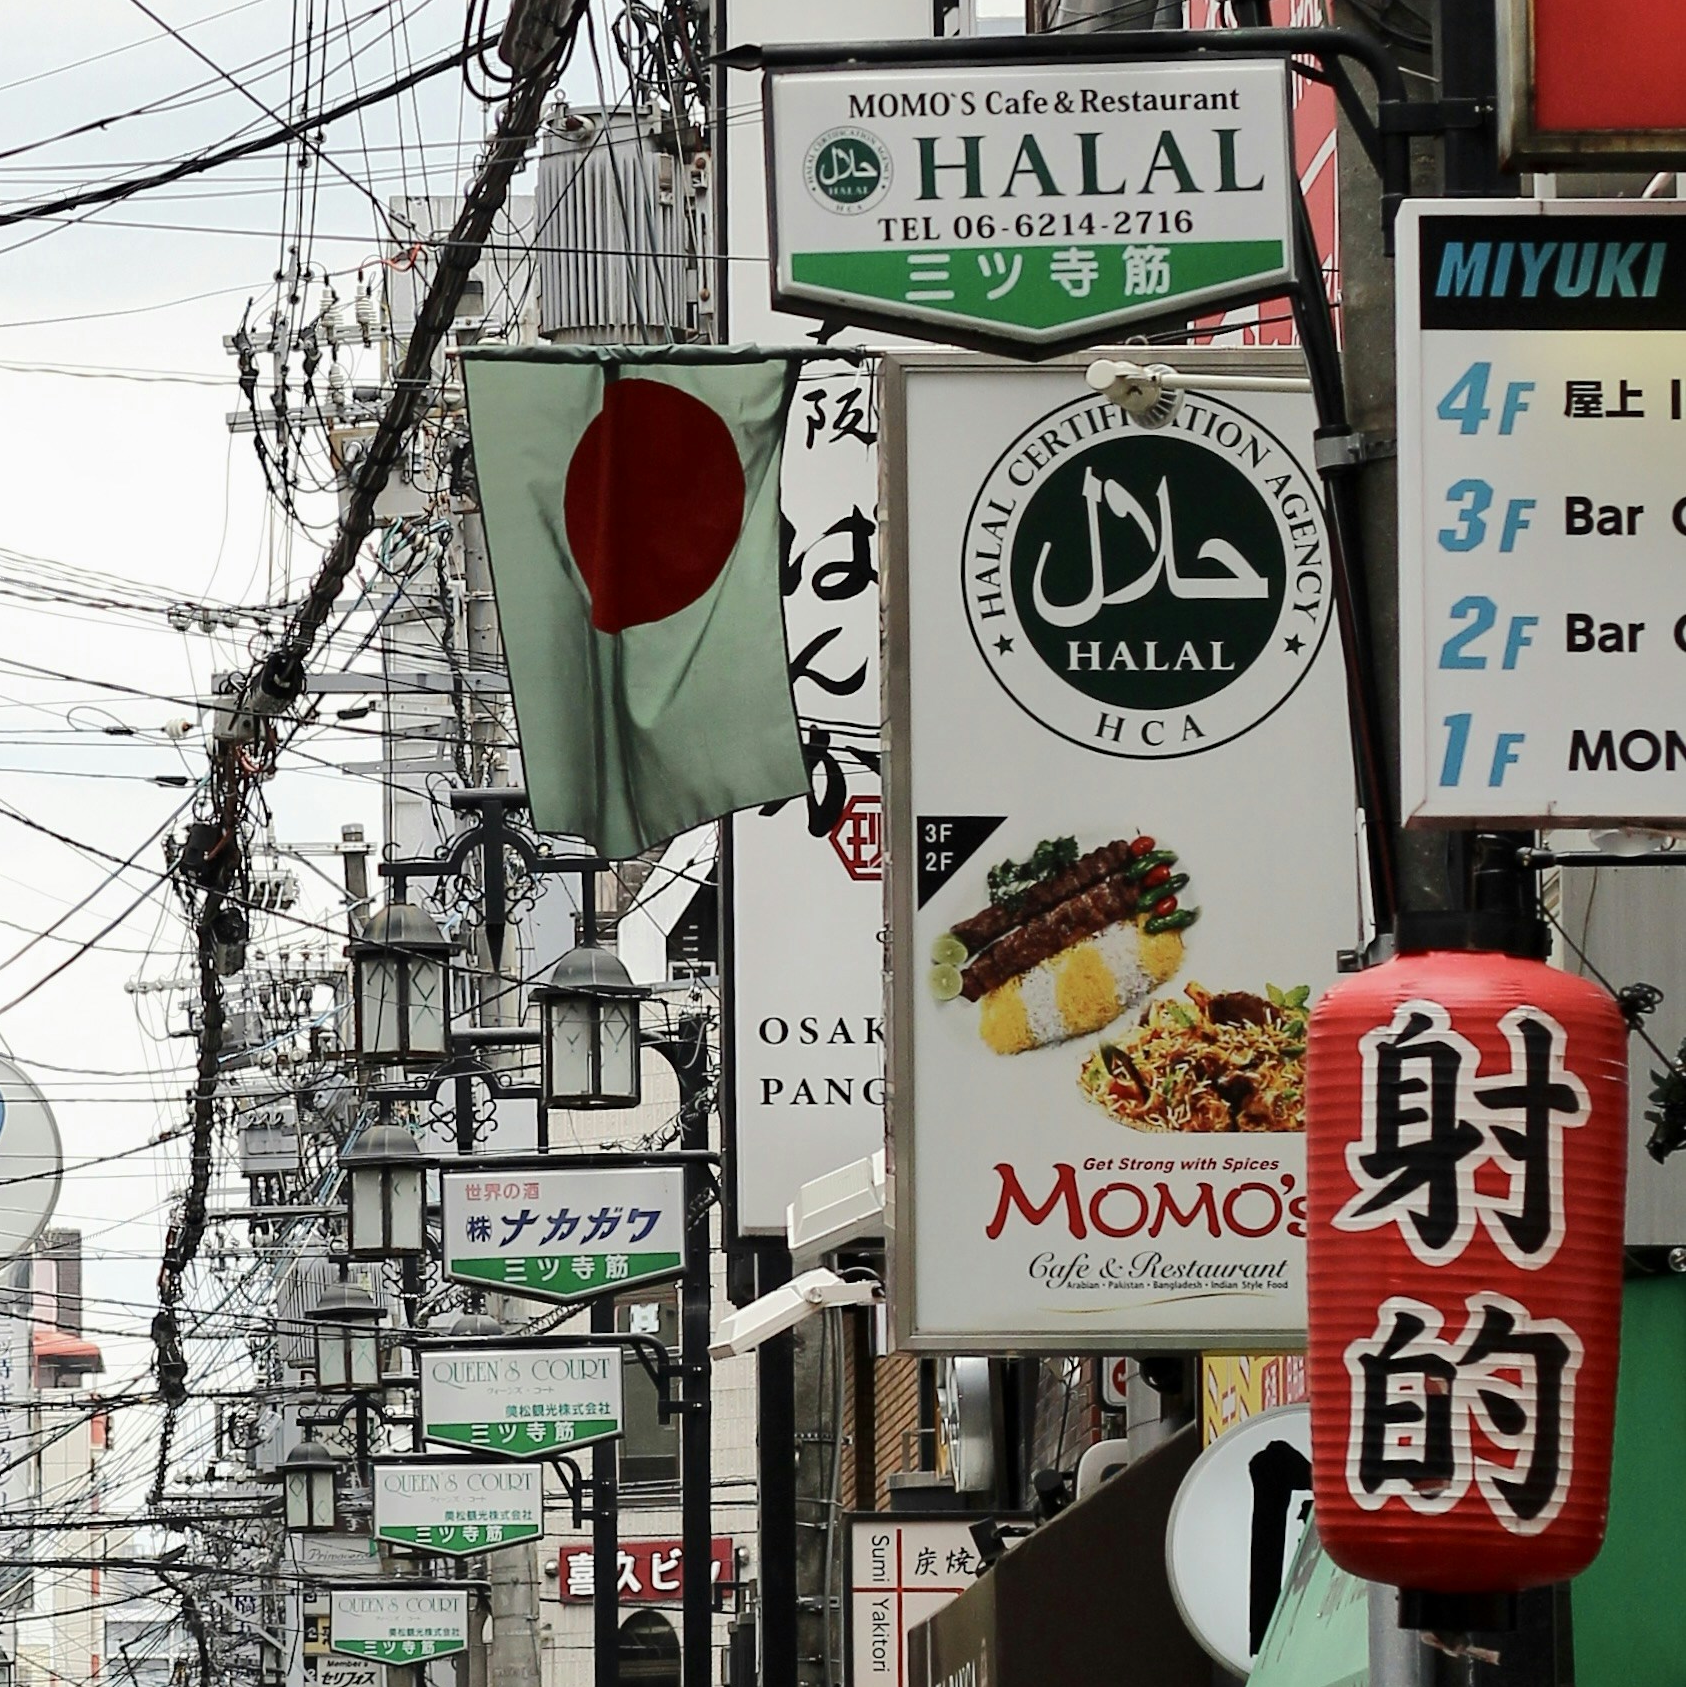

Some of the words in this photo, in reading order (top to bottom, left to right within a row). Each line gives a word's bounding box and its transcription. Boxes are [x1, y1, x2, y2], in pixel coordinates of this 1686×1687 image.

[985, 91, 1048, 115] Cafe
[1055, 90, 1075, 113] &
[1081, 88, 1241, 113] Restaurant
[914, 128, 1265, 201] HALAL
[878, 217, 941, 242] TEL
[954, 210, 1194, 239] 06-6214-2716
[905, 245, 1171, 300] 三ツ寺筋
[1435, 242, 1667, 298] MIYUKI
[1437, 362, 1536, 435] 4F
[1563, 379, 1645, 419] 屋上
[1438, 479, 1536, 553] 3F
[1565, 496, 1645, 536] Bar
[975, 498, 1017, 621] HALAL
[1264, 474, 1323, 622] AGENCY
[1033, 466, 1269, 628] حلال
[1439, 596, 1539, 670] 2F
[1566, 613, 1645, 653] Bar
[1067, 641, 1235, 671] HALAL
[1095, 711, 1206, 746] HCA
[1439, 713, 1525, 787] 1F
[925, 824, 952, 843] 3F
[925, 852, 953, 872] 2F
[1083, 1158, 1112, 1171] Get
[1119, 1158, 1174, 1173] Strong
[1181, 1158, 1216, 1171] with
[1222, 1158, 1279, 1173] Spices
[465, 1182, 540, 1202] 世界の酒
[504, 1254, 629, 1283] 三ツ寺筋
[1028, 1251, 1089, 1290] Cafe
[1099, 1257, 1125, 1279] &
[1128, 1250, 1289, 1279] Restaurant
[1338, 1001, 1586, 1530] 射的
[1067, 1281, 1100, 1290] Arabian
[1108, 1281, 1144, 1290] Pakistan
[1153, 1281, 1203, 1291] Bangladesh
[1211, 1281, 1239, 1290] Indian
[1242, 1281, 1263, 1291] Style
[1267, 1281, 1289, 1290] Food
[432, 1358, 521, 1390] QUEEN'S
[531, 1357, 611, 1381] COURT
[470, 1420, 576, 1445] 三ツ寺筋
[384, 1472, 458, 1498] QUEEN'S
[466, 1472, 533, 1492] COURT
[415, 1524, 504, 1544] 三ツ寺筋
[871, 1535, 890, 1582] Sumi
[338, 1597, 398, 1618] QUEEN'S
[406, 1596, 461, 1613] COURT
[364, 1640, 436, 1656] 三ツ寺筋
[871, 1598, 891, 1673] Yakitori
